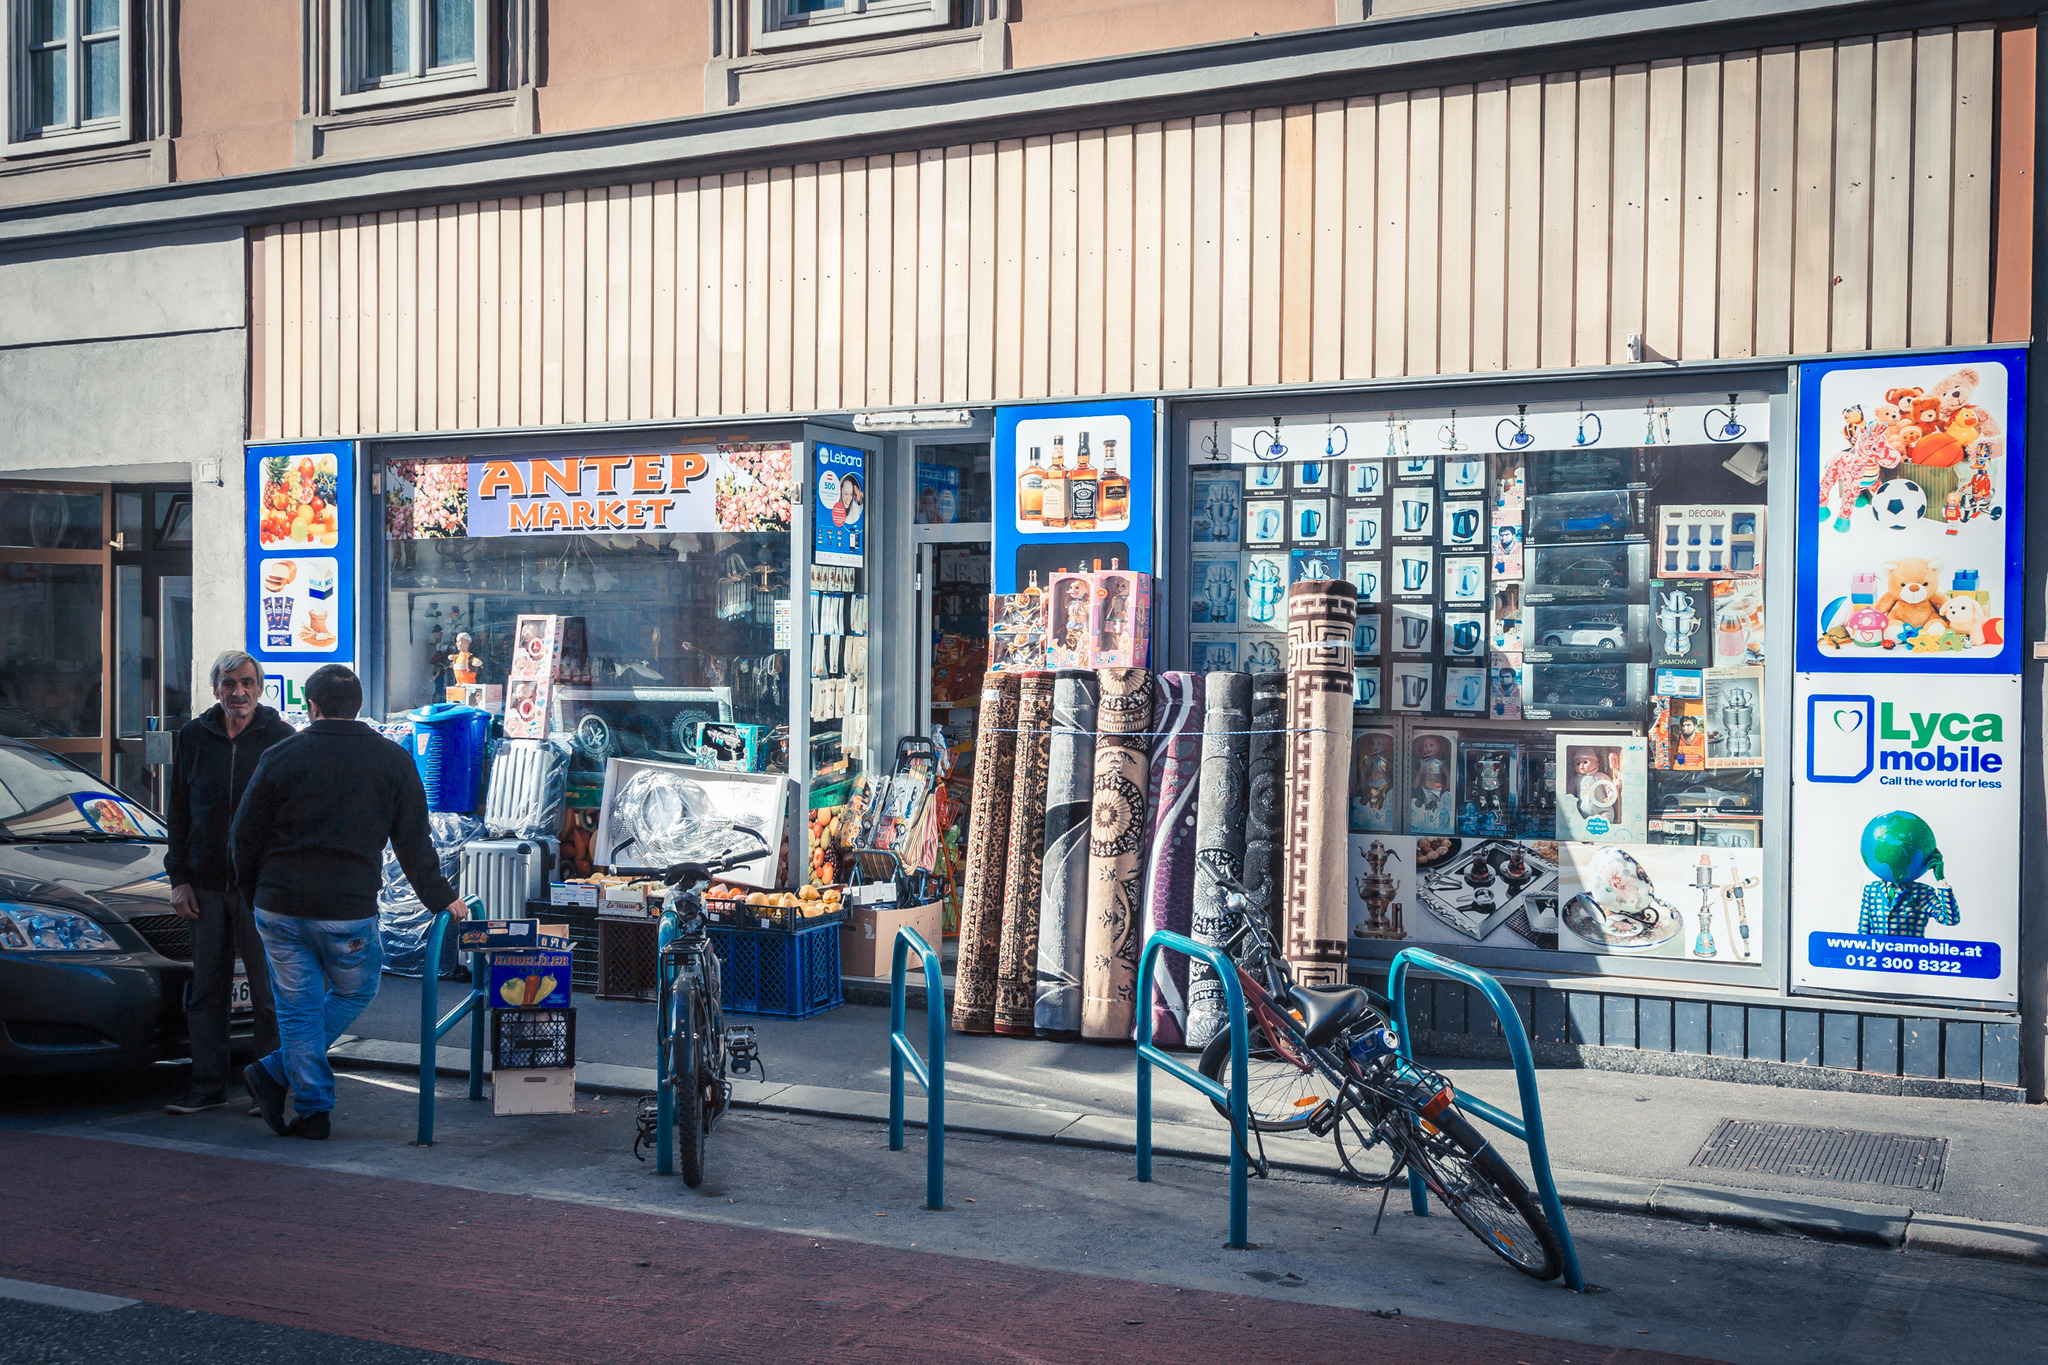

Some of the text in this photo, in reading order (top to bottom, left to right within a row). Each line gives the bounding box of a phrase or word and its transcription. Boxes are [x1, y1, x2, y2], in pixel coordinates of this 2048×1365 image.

[829, 449, 862, 467] Lebara
[478, 453, 709, 500] ANTEP
[824, 482, 836, 490] 500
[508, 498, 675, 533] MARKET
[1688, 509, 1727, 518] DECORIA
[309, 578, 322, 587] MILK
[1570, 650, 1601, 660] QX 56
[1568, 709, 1599, 719] QX 56
[1880, 702, 2003, 749] Lyca
[1880, 745, 2003, 773] mobile
[1880, 776, 2002, 789] Call the world for less
[1827, 937, 1982, 958] www.lycamobile.at
[494, 953, 570, 966] KORELİLER
[1846, 954, 1962, 974] 012 300 8322
